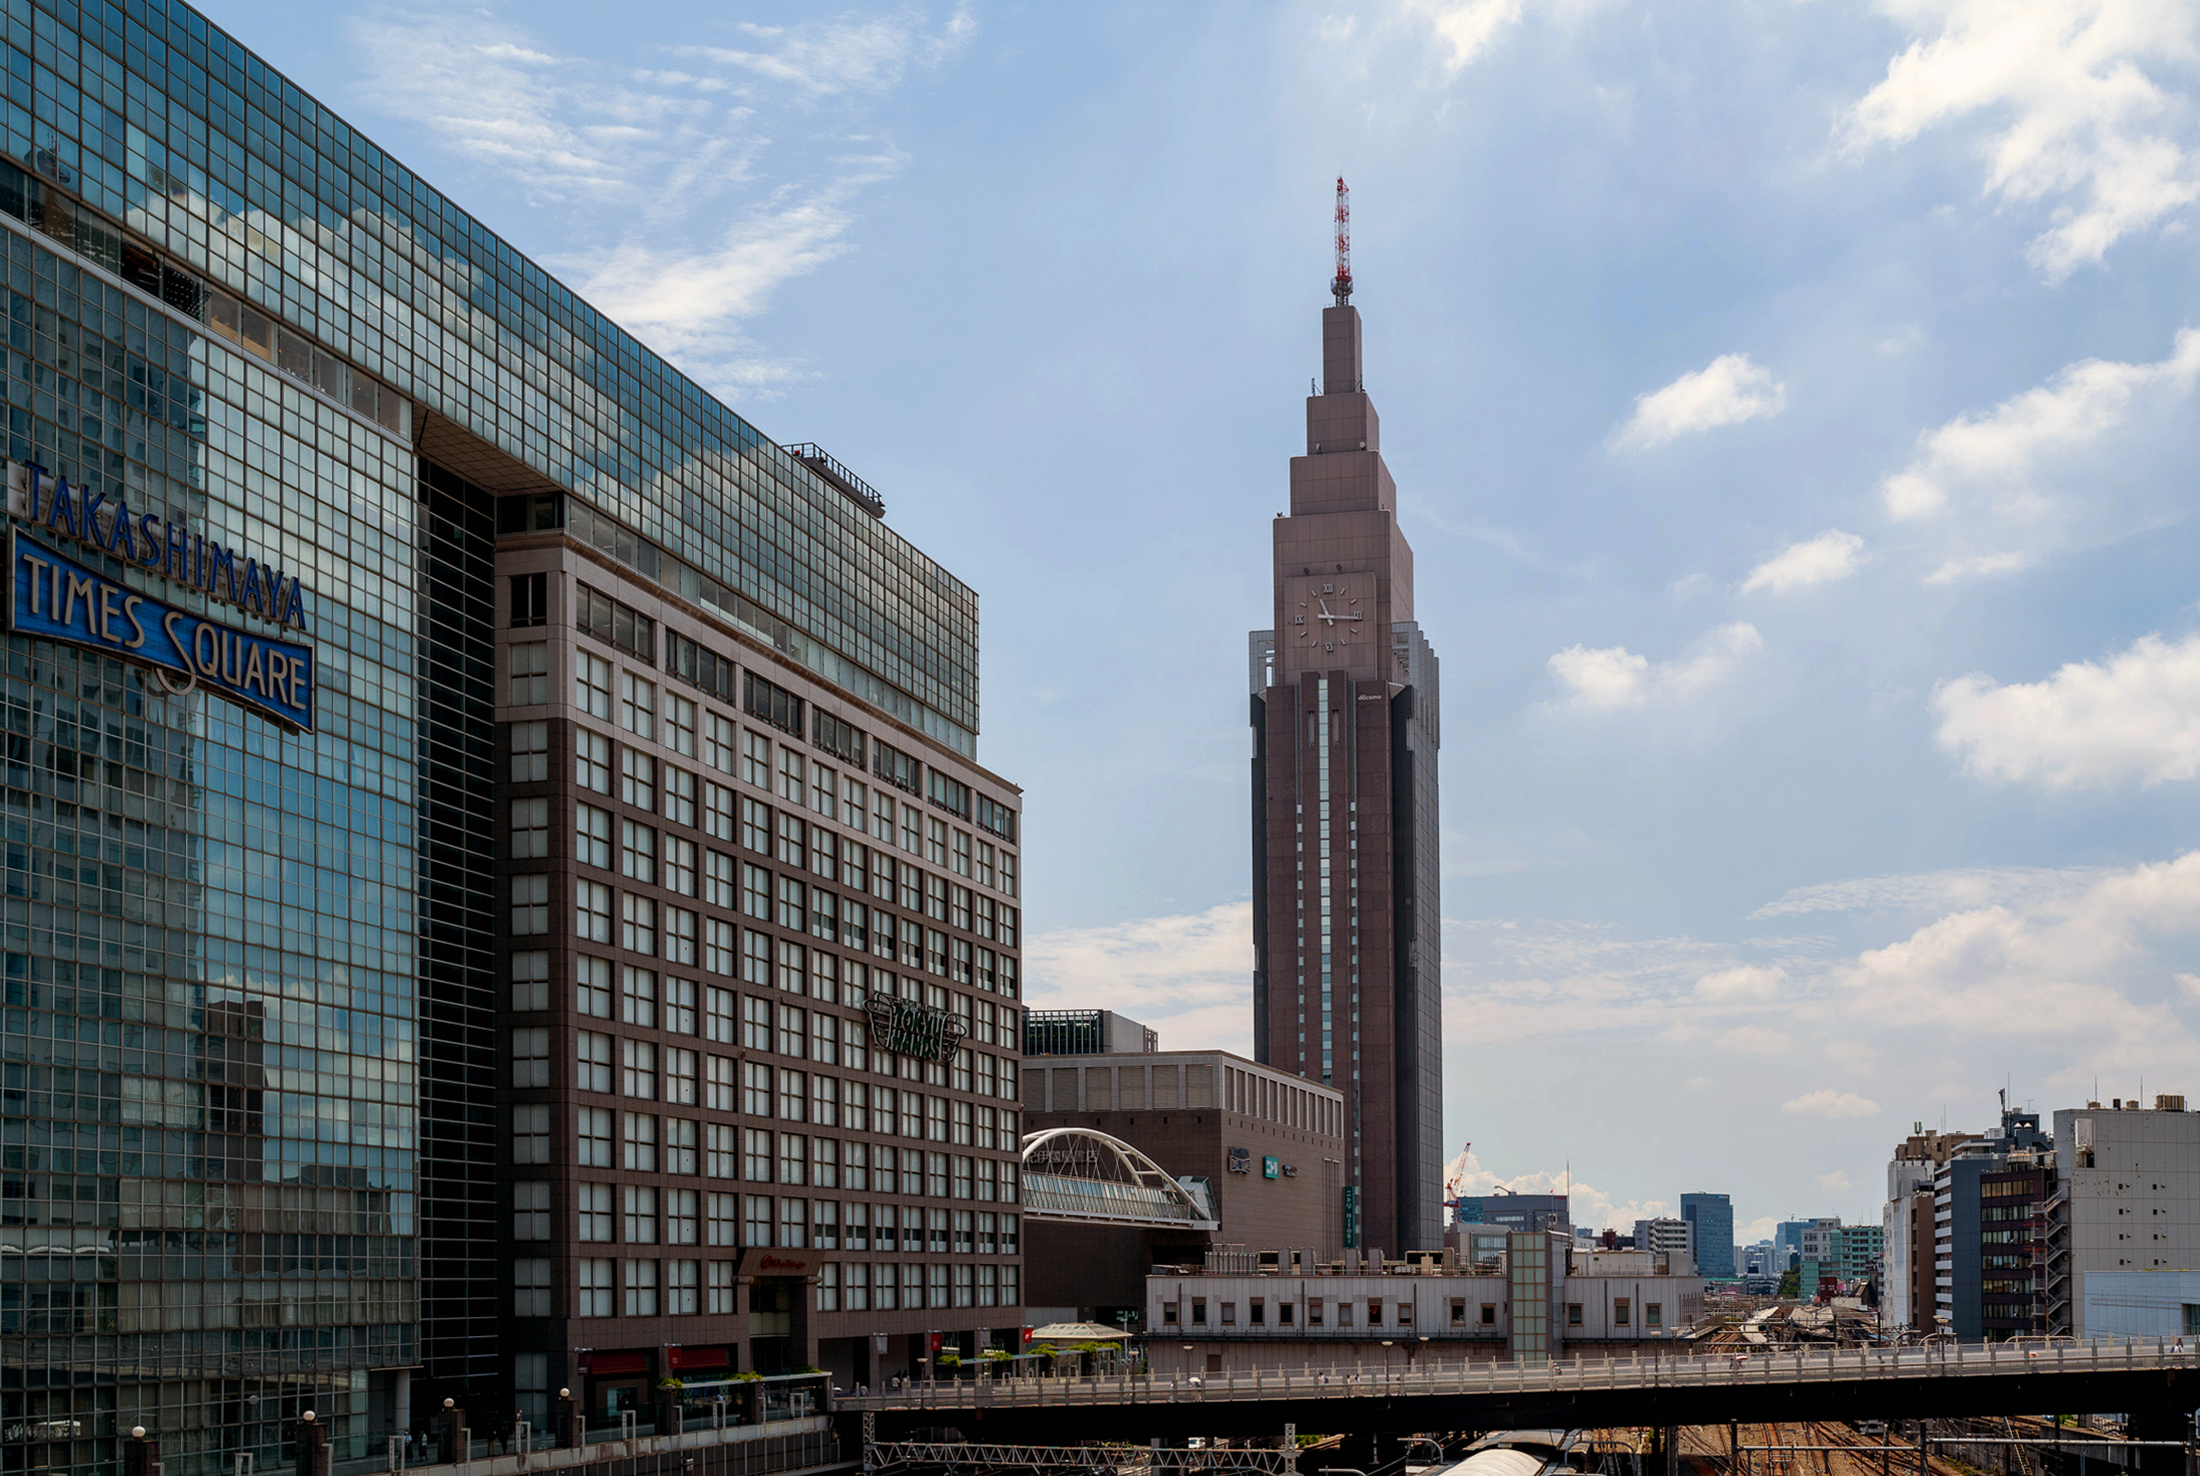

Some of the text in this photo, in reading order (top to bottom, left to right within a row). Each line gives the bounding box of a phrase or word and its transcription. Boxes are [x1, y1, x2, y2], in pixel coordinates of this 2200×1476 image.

[24, 459, 307, 631] TAKASHIMAYA
[23, 553, 307, 711] TIMES SQUARE
[890, 1028, 940, 1061] HANDS
[892, 1005, 940, 1039] TOKYU
